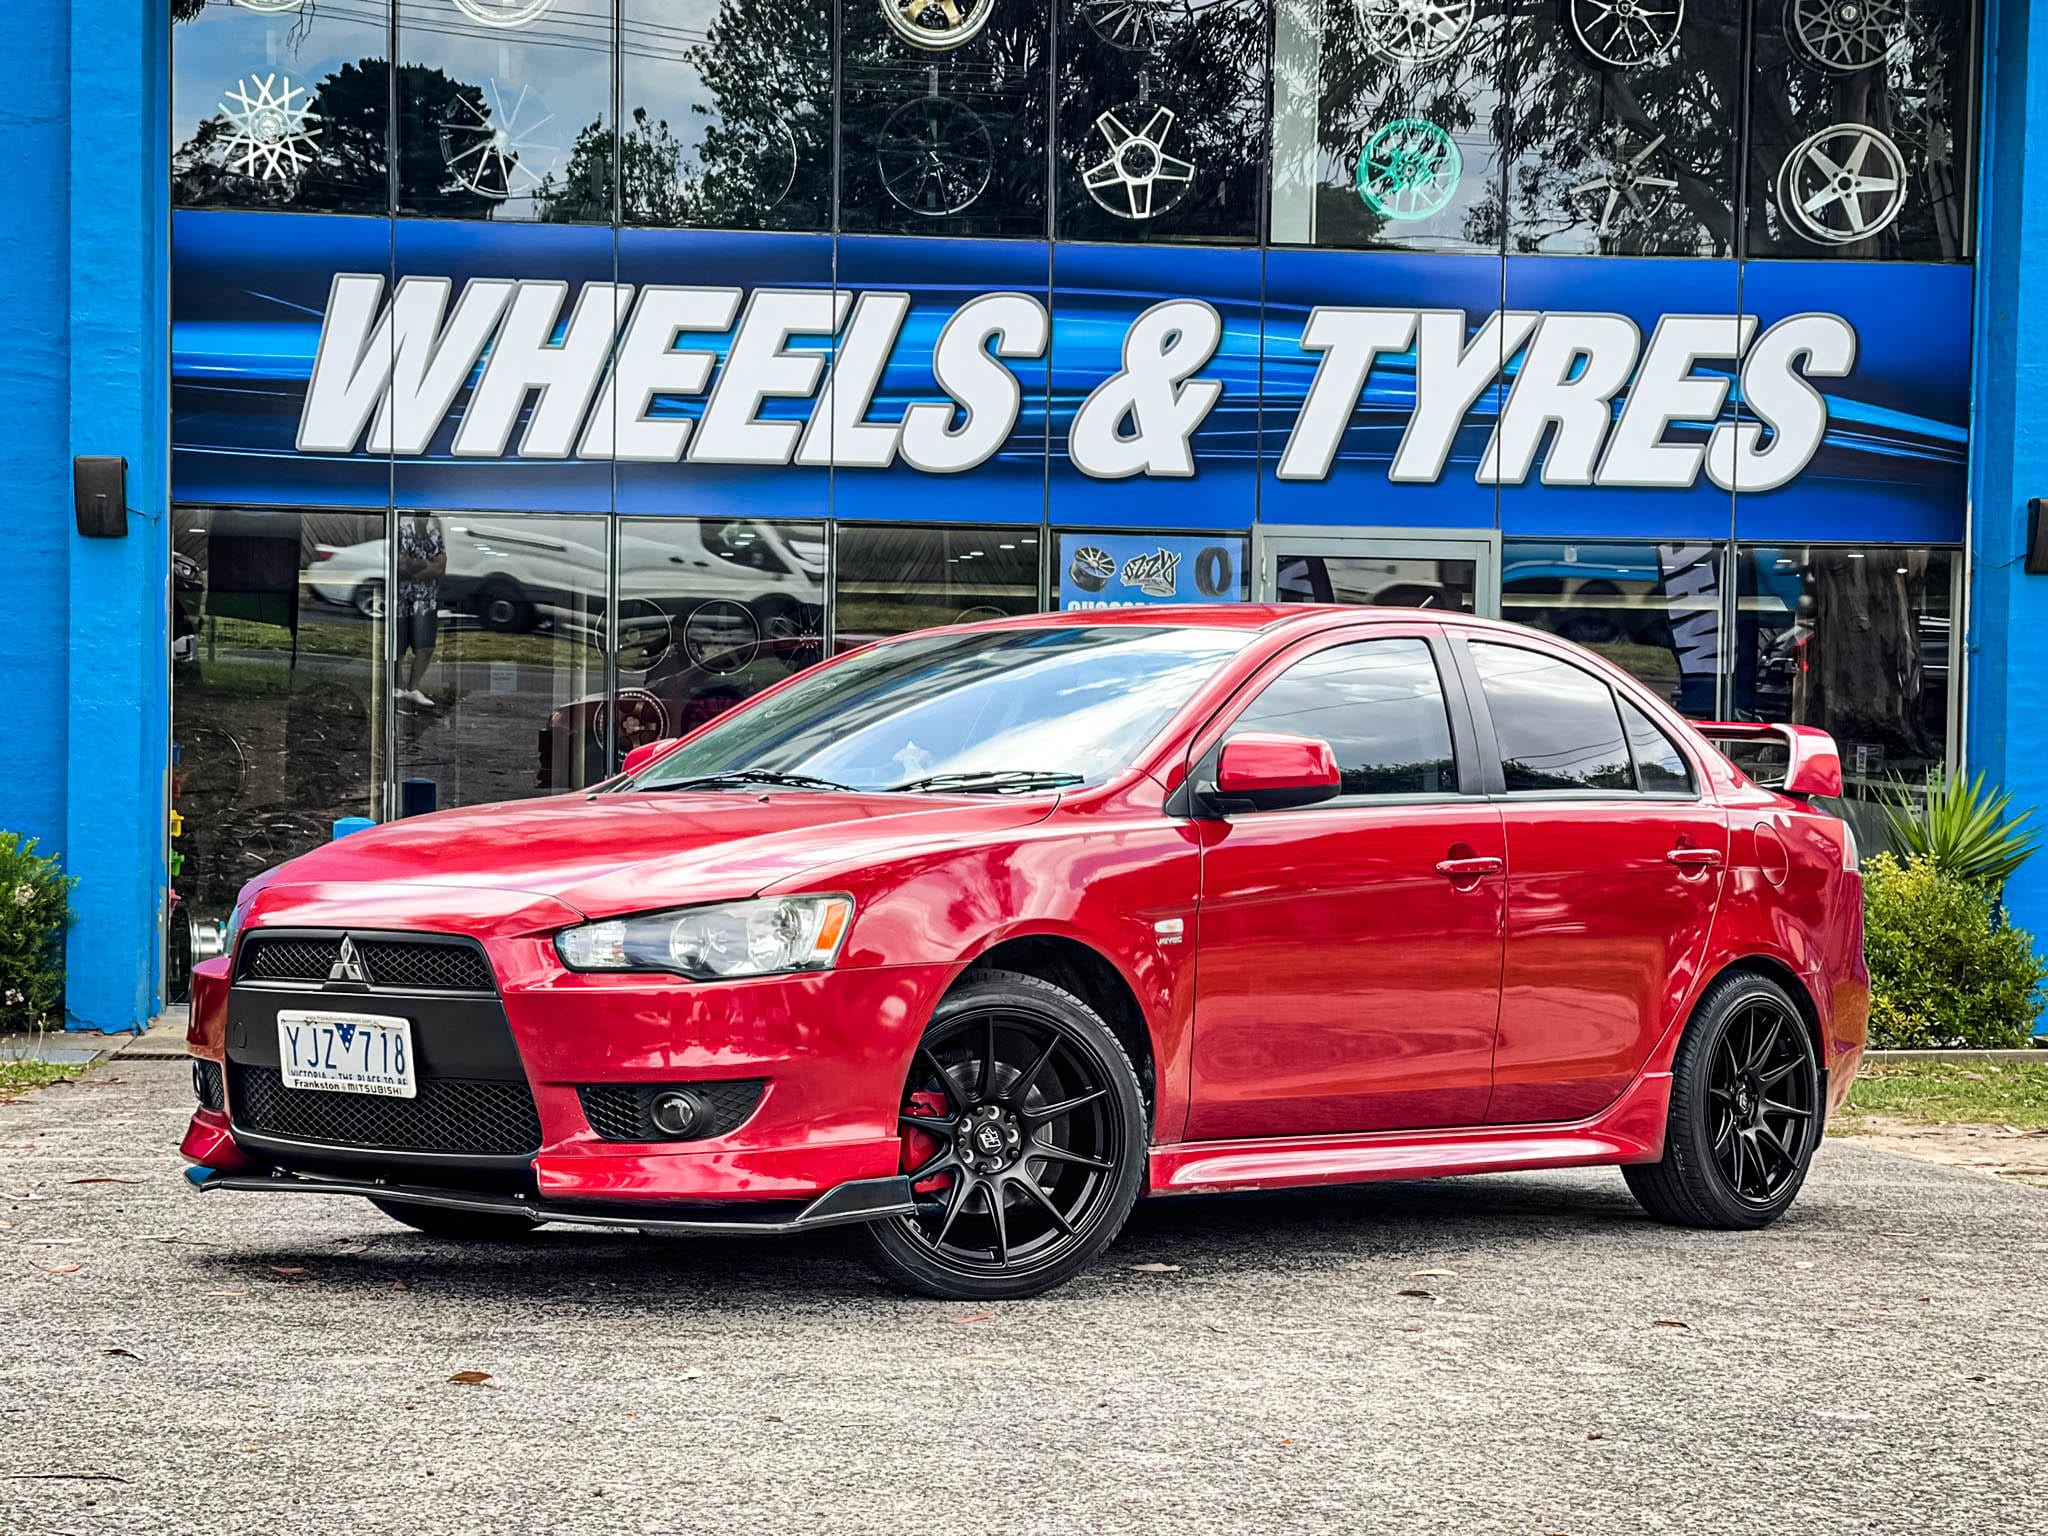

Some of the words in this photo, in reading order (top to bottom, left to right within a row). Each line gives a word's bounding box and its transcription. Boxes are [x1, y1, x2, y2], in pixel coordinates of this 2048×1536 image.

[295, 272, 1048, 473] WHEELS
[1067, 298, 1222, 478] &
[1275, 305, 1857, 492] TYRES
[286, 1025, 337, 1070] YJZ
[358, 1031, 406, 1076] 718
[294, 1078, 340, 1090] Frankston
[347, 1082, 403, 1095] MITSUBISHI
